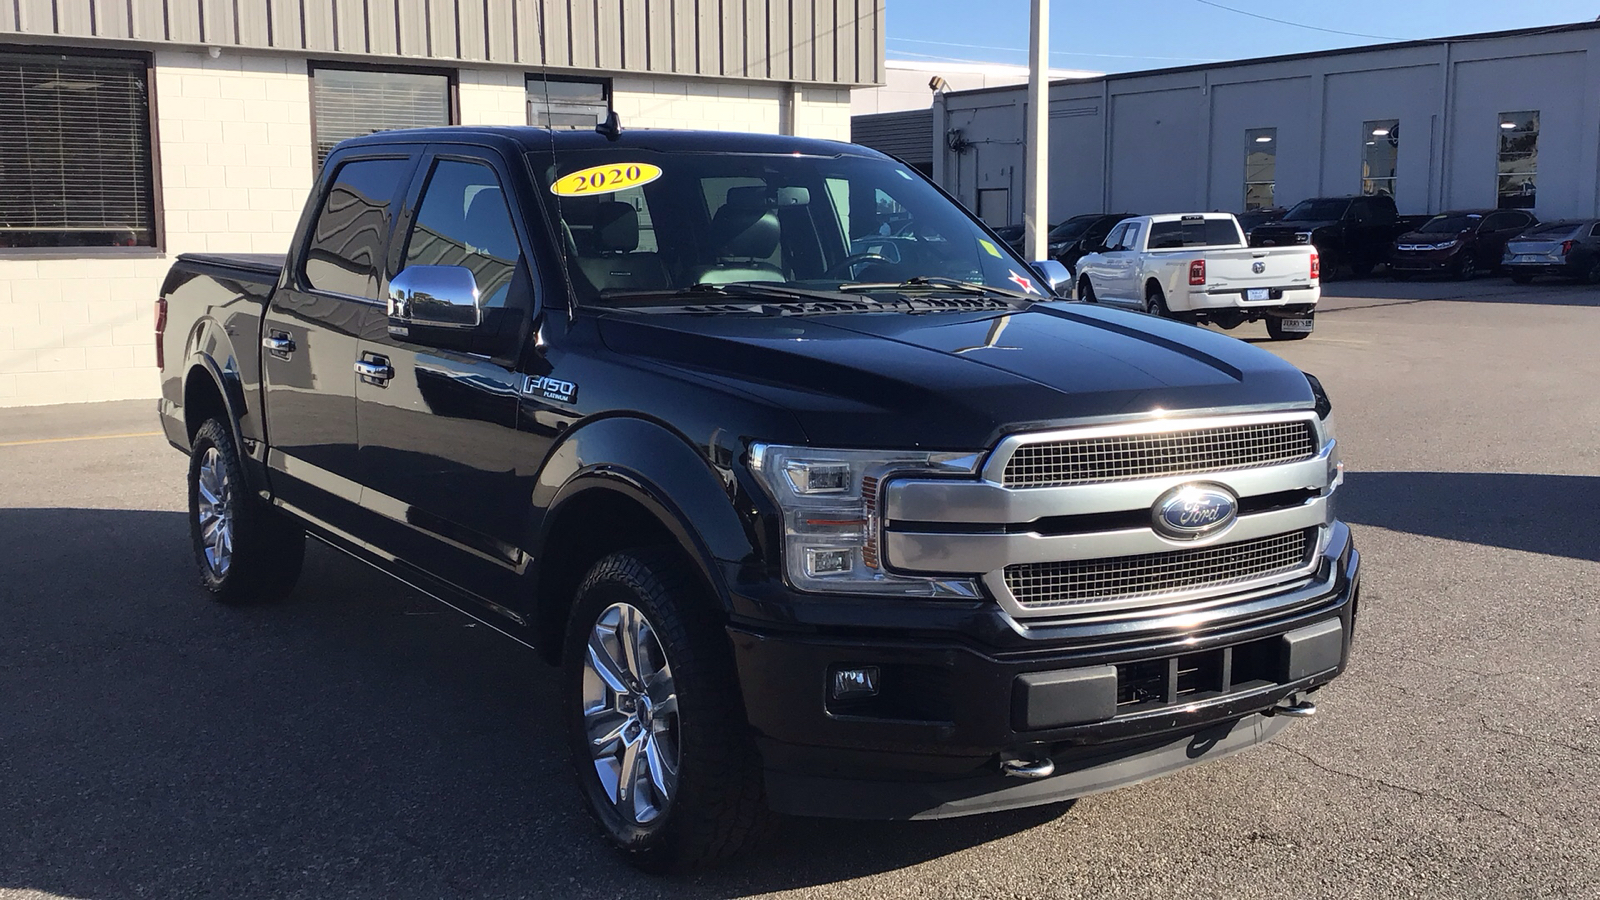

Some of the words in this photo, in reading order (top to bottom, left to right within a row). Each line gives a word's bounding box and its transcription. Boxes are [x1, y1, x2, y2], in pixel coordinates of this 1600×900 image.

[573, 165, 641, 192] 2020
[543, 391, 569, 401] PLATINUM
[1180, 498, 1221, 525] Ford
